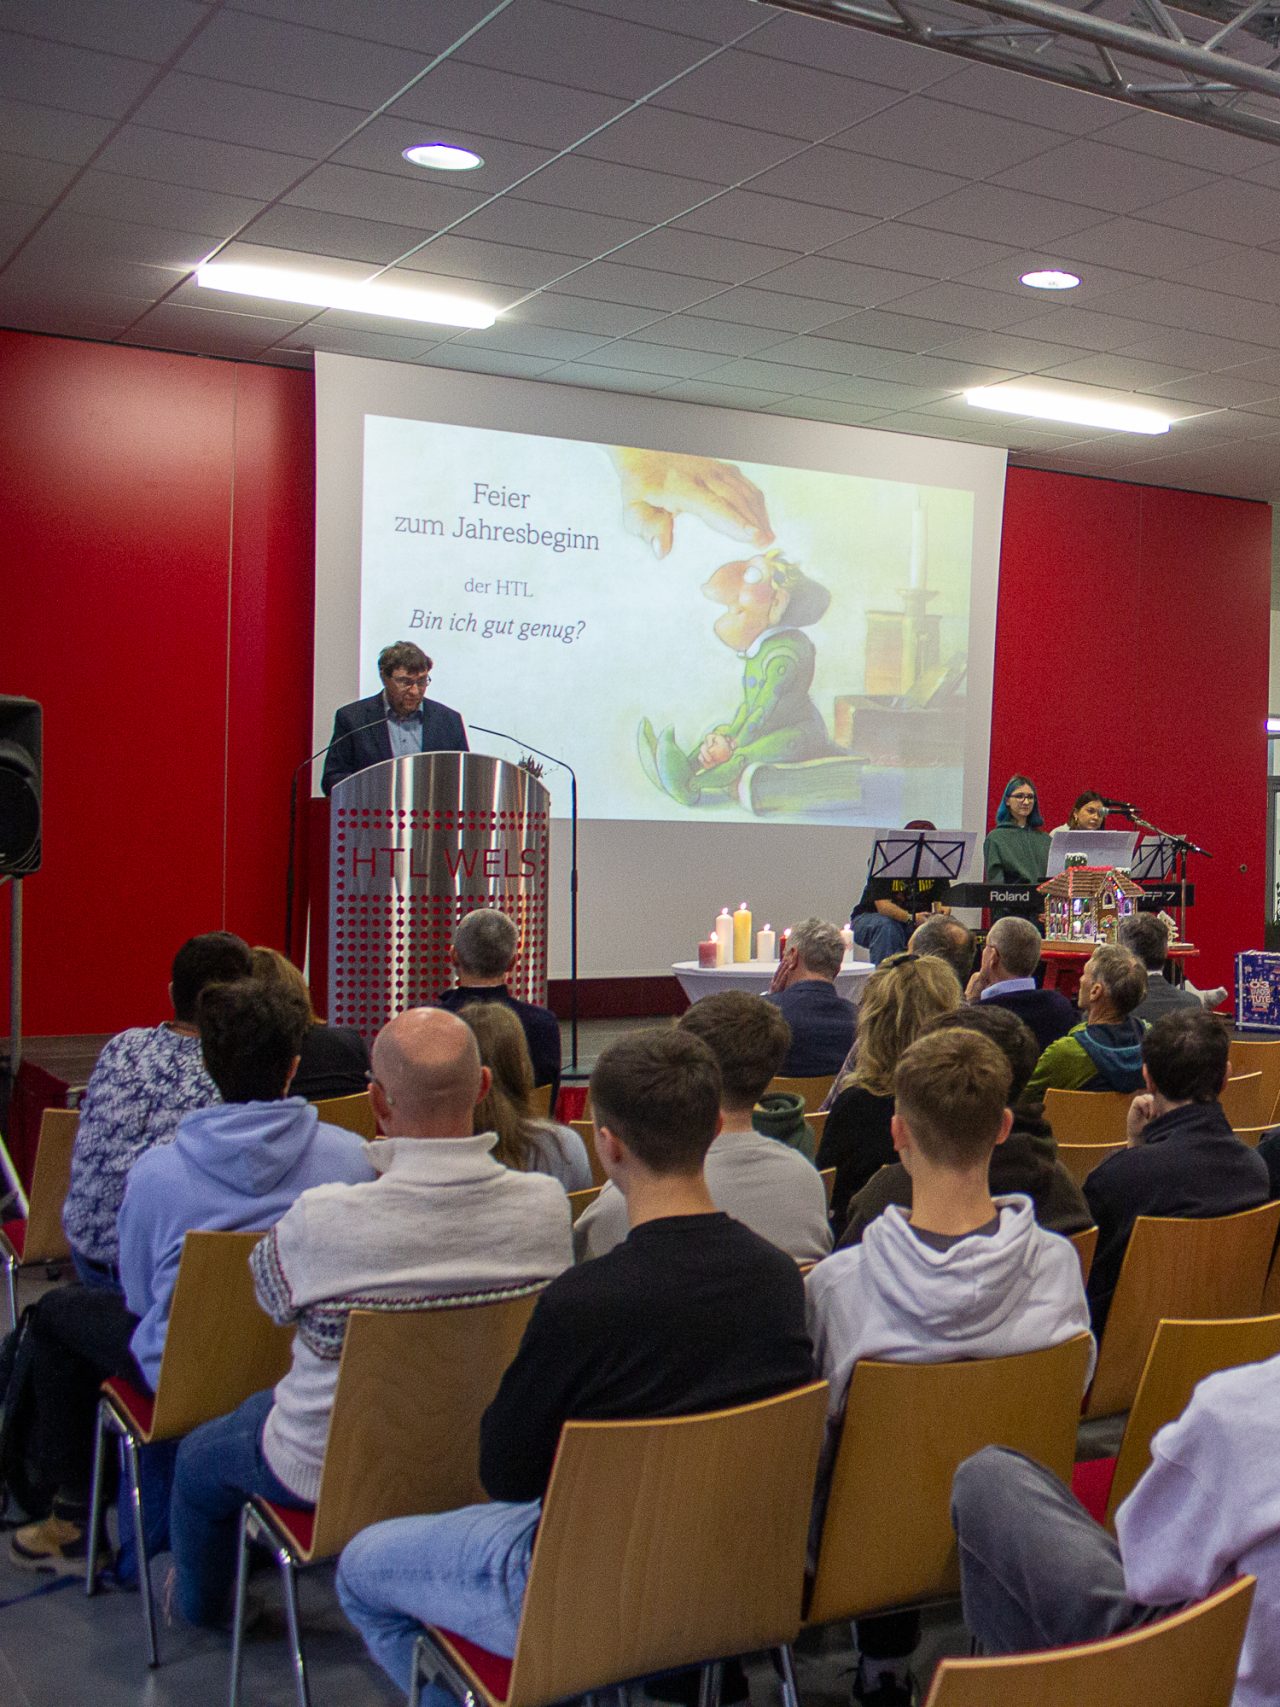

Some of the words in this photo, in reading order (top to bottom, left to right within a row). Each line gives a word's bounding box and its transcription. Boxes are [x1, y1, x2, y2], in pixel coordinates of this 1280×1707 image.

[473, 482, 531, 509] Feier
[395, 516, 445, 536] zum
[452, 516, 600, 553] Jahresbeginn
[464, 577, 492, 594] der
[496, 579, 534, 597] HTL
[408, 608, 443, 630] Bin
[449, 612, 477, 632] ich
[481, 619, 515, 638] gut
[517, 620, 586, 644] genug?
[352, 848, 429, 879] HTL
[444, 848, 537, 879] WELS
[990, 891, 1030, 902] Roland
